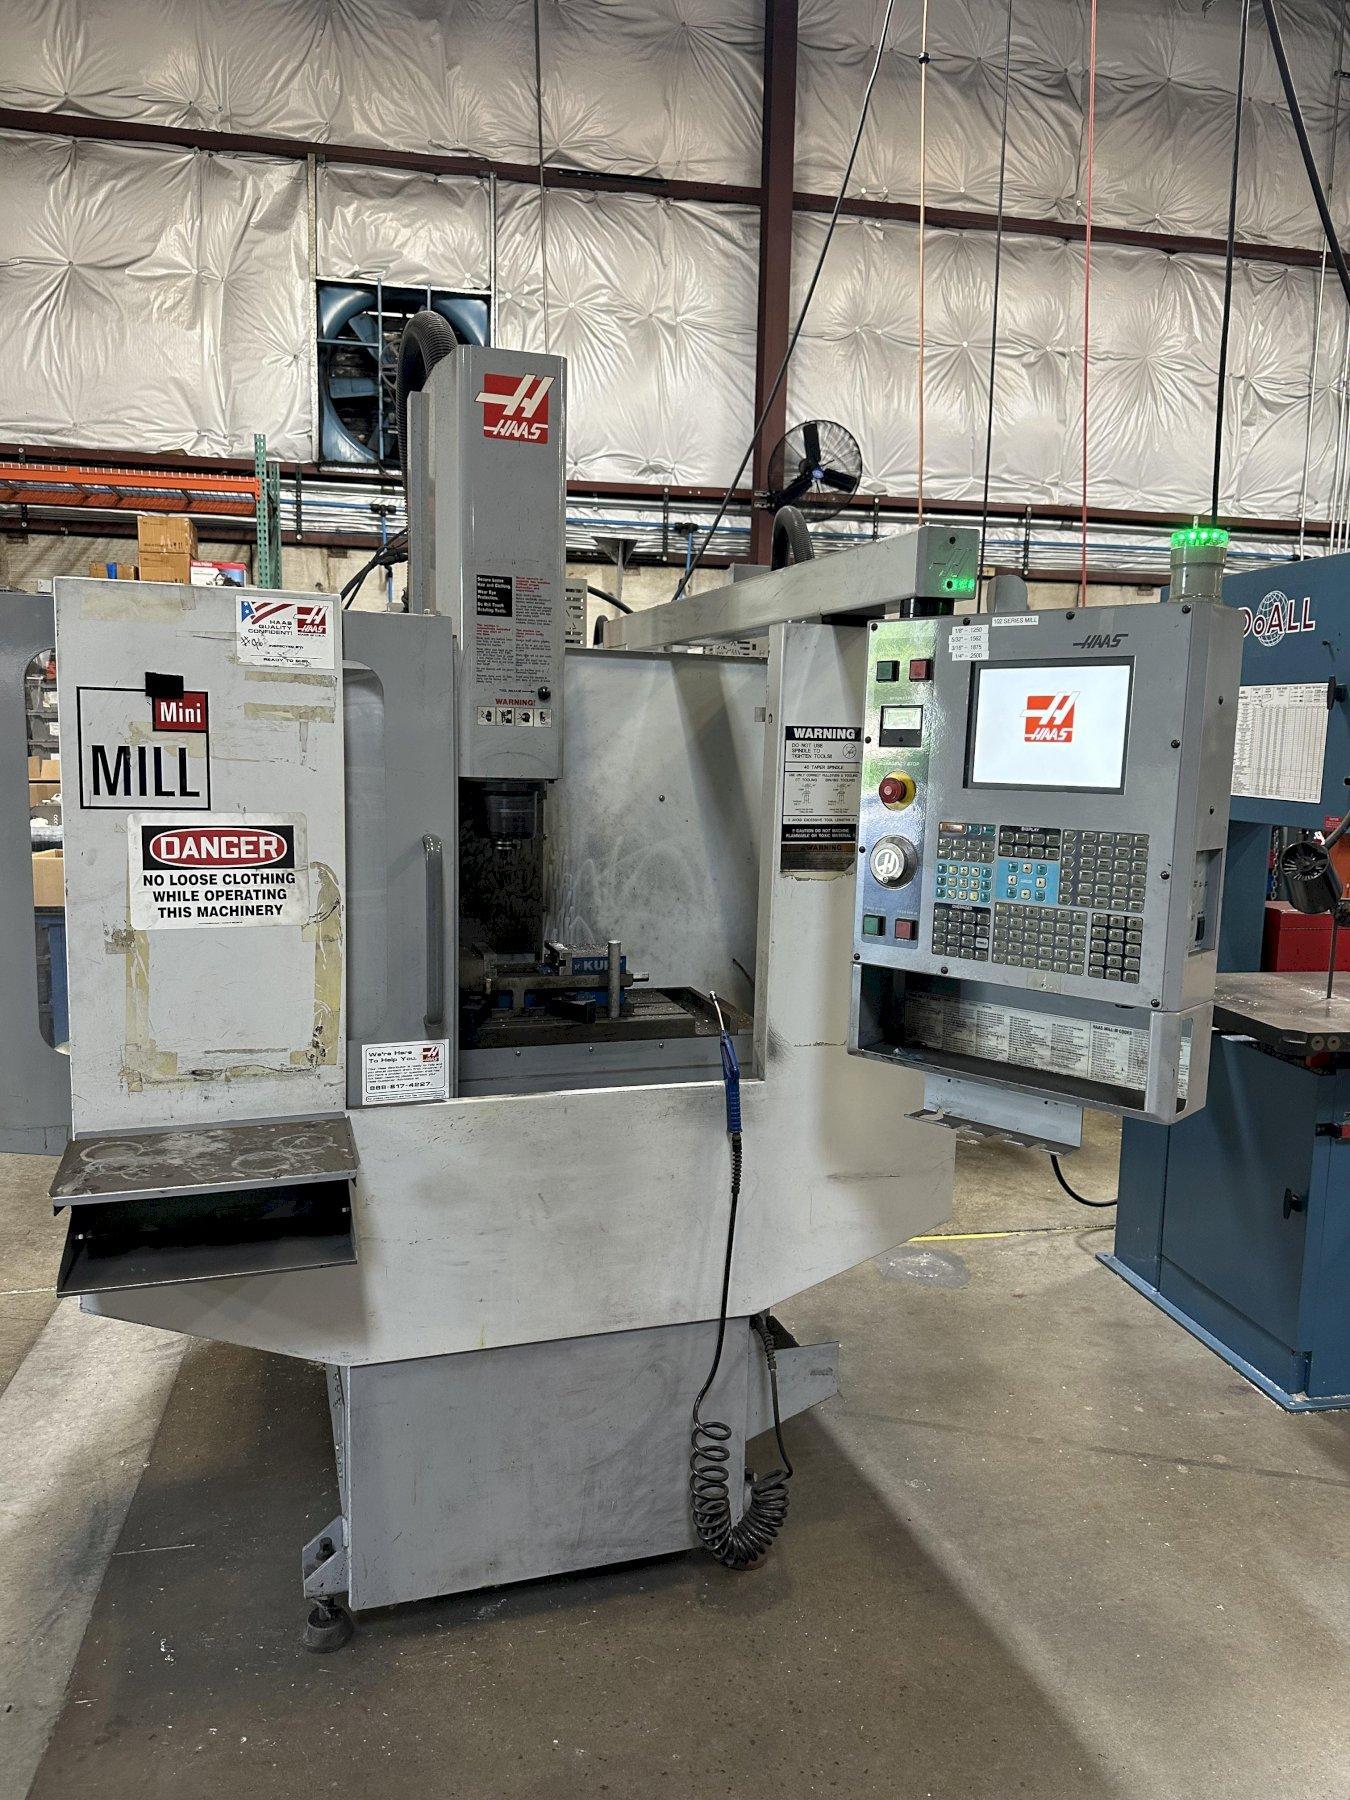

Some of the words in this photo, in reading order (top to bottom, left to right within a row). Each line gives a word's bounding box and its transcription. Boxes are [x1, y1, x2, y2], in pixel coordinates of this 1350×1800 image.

[483, 419, 548, 440] HAAS
[1072, 633, 1129, 649] HAAS
[495, 698, 536, 706] WARNING!
[160, 701, 201, 723] Mini
[793, 727, 856, 740] WARNING
[1024, 727, 1073, 741] HAAS
[91, 745, 201, 797] MILL
[160, 836, 278, 859] DANGER
[143, 874, 165, 886] NO
[169, 873, 217, 885] LOOSE
[222, 872, 296, 885] CLOTHING
[152, 890, 199, 902] WHILE
[204, 888, 287, 901] OPERATING
[157, 906, 192, 919] THIS
[197, 904, 283, 918] MACHINERY
